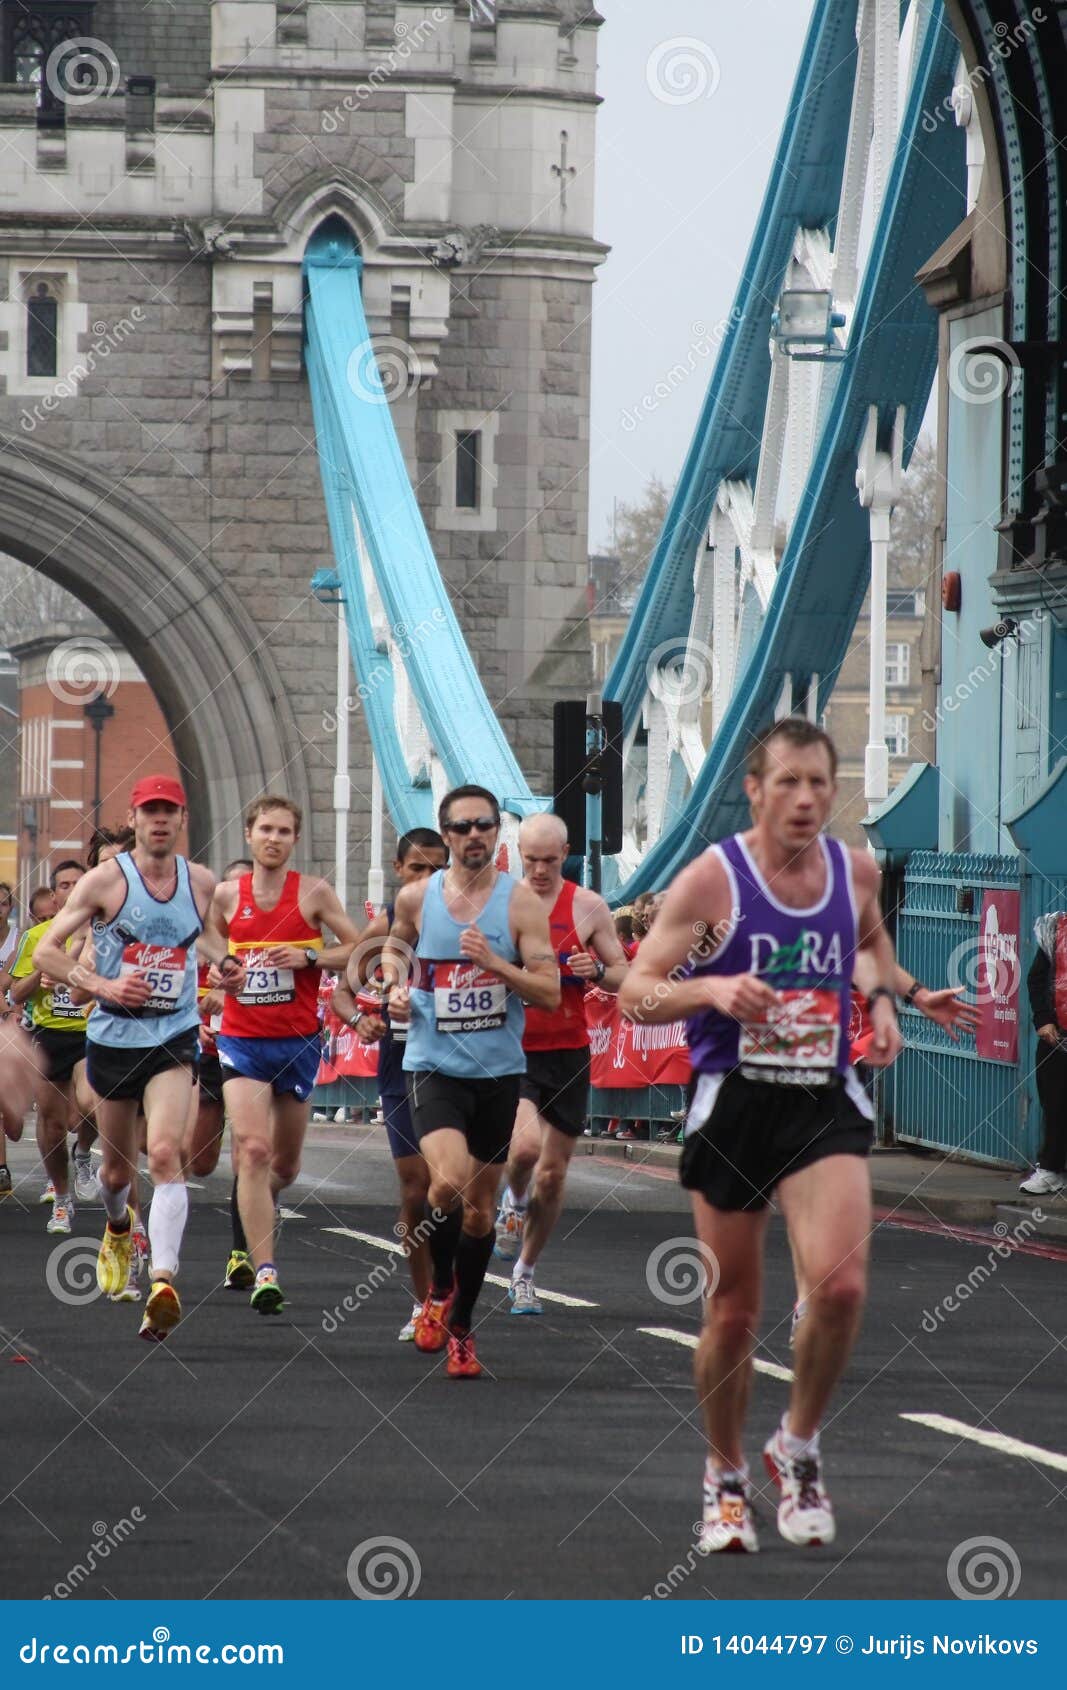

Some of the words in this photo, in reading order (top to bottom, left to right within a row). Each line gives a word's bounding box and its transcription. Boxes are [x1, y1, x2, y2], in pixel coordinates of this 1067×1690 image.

[136, 944, 174, 968] Virgin
[136, 969, 174, 993] 55
[246, 969, 279, 989] 731
[256, 993, 291, 1004] adidas
[448, 991, 493, 1013] 548
[463, 1018, 502, 1030] adidas
